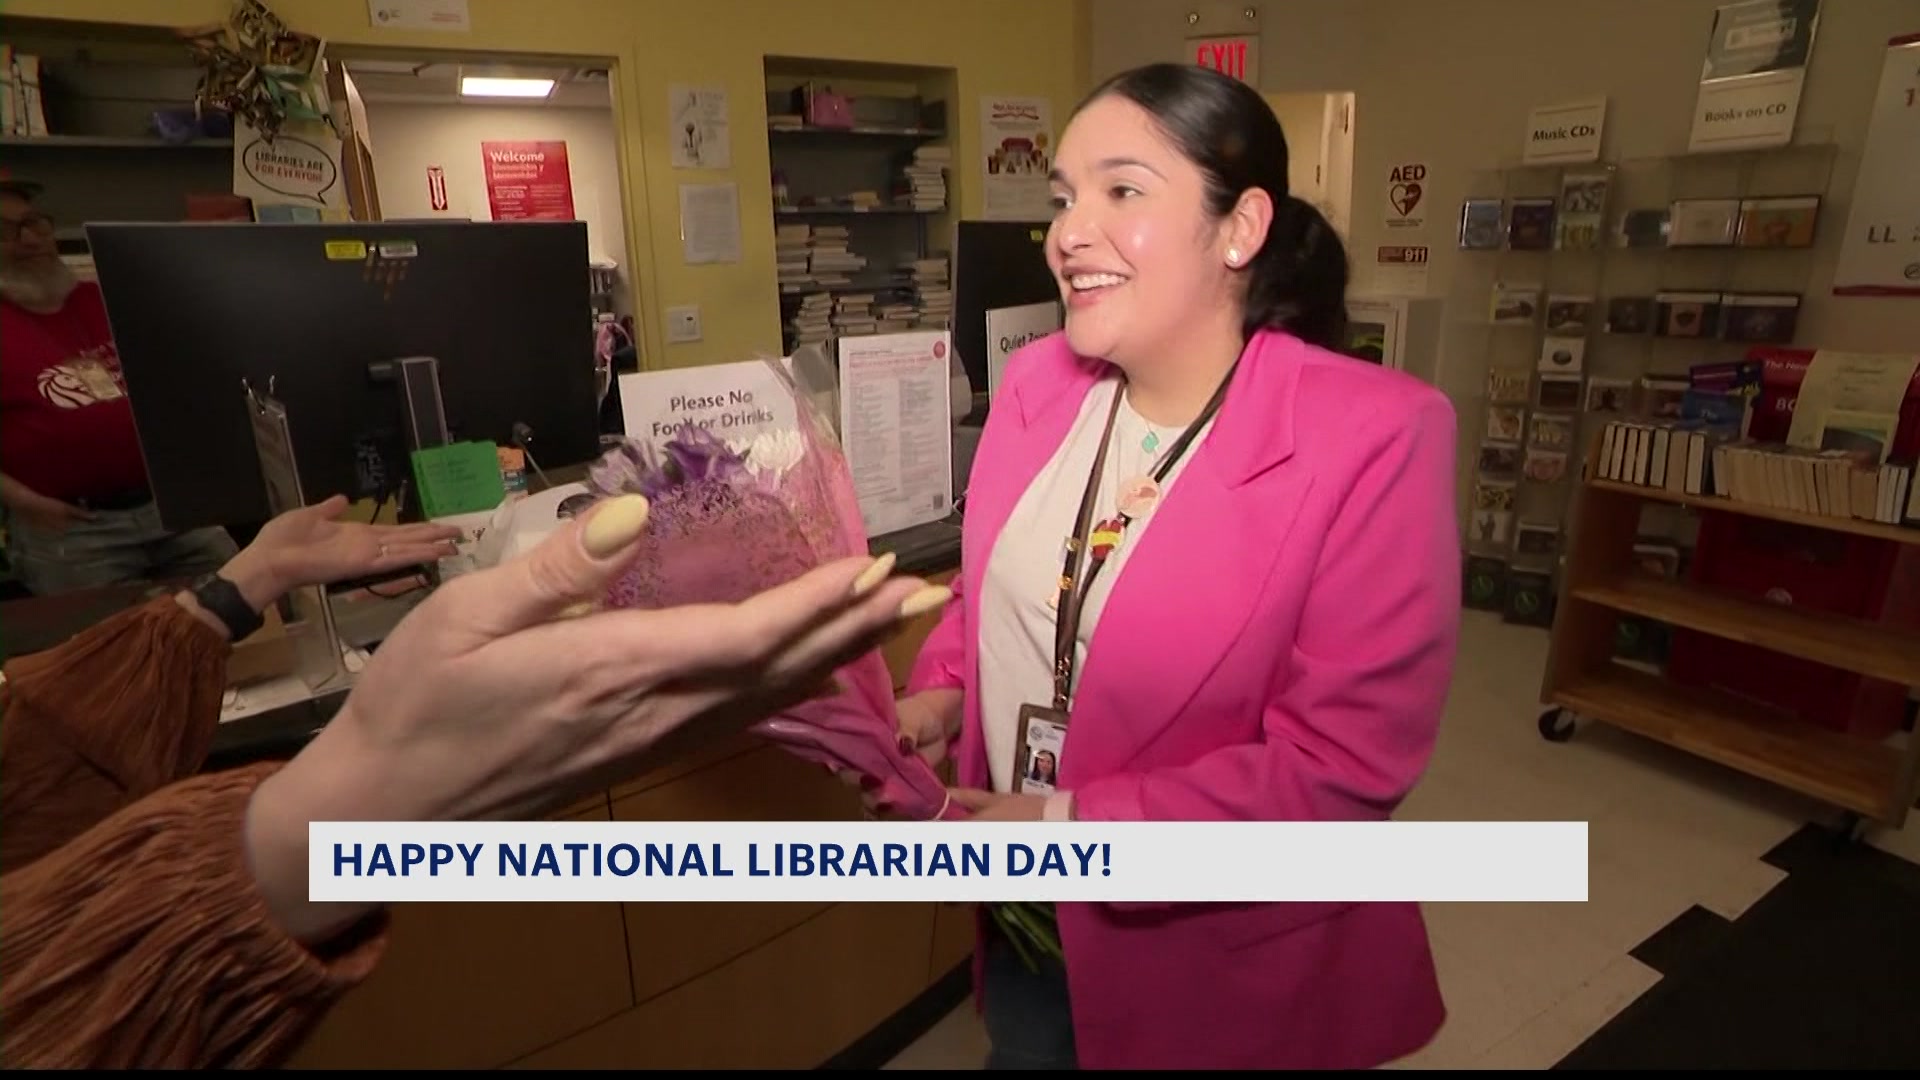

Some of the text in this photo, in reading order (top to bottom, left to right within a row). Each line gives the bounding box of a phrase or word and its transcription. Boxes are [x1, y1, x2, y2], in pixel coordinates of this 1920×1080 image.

[1196, 43, 1247, 80] EXIT
[1704, 103, 1786, 122] Books on CD
[1532, 125, 1596, 142] Music CDs
[490, 150, 545, 163] Welcome
[255, 163, 274, 174] FOR
[1389, 164, 1426, 183] AED
[1867, 226, 1897, 244] LL
[1404, 247, 1427, 262] 911
[1000, 334, 1026, 354] Quiet
[670, 389, 753, 412] Please No
[699, 418, 717, 430] or
[721, 409, 774, 428] Drinks
